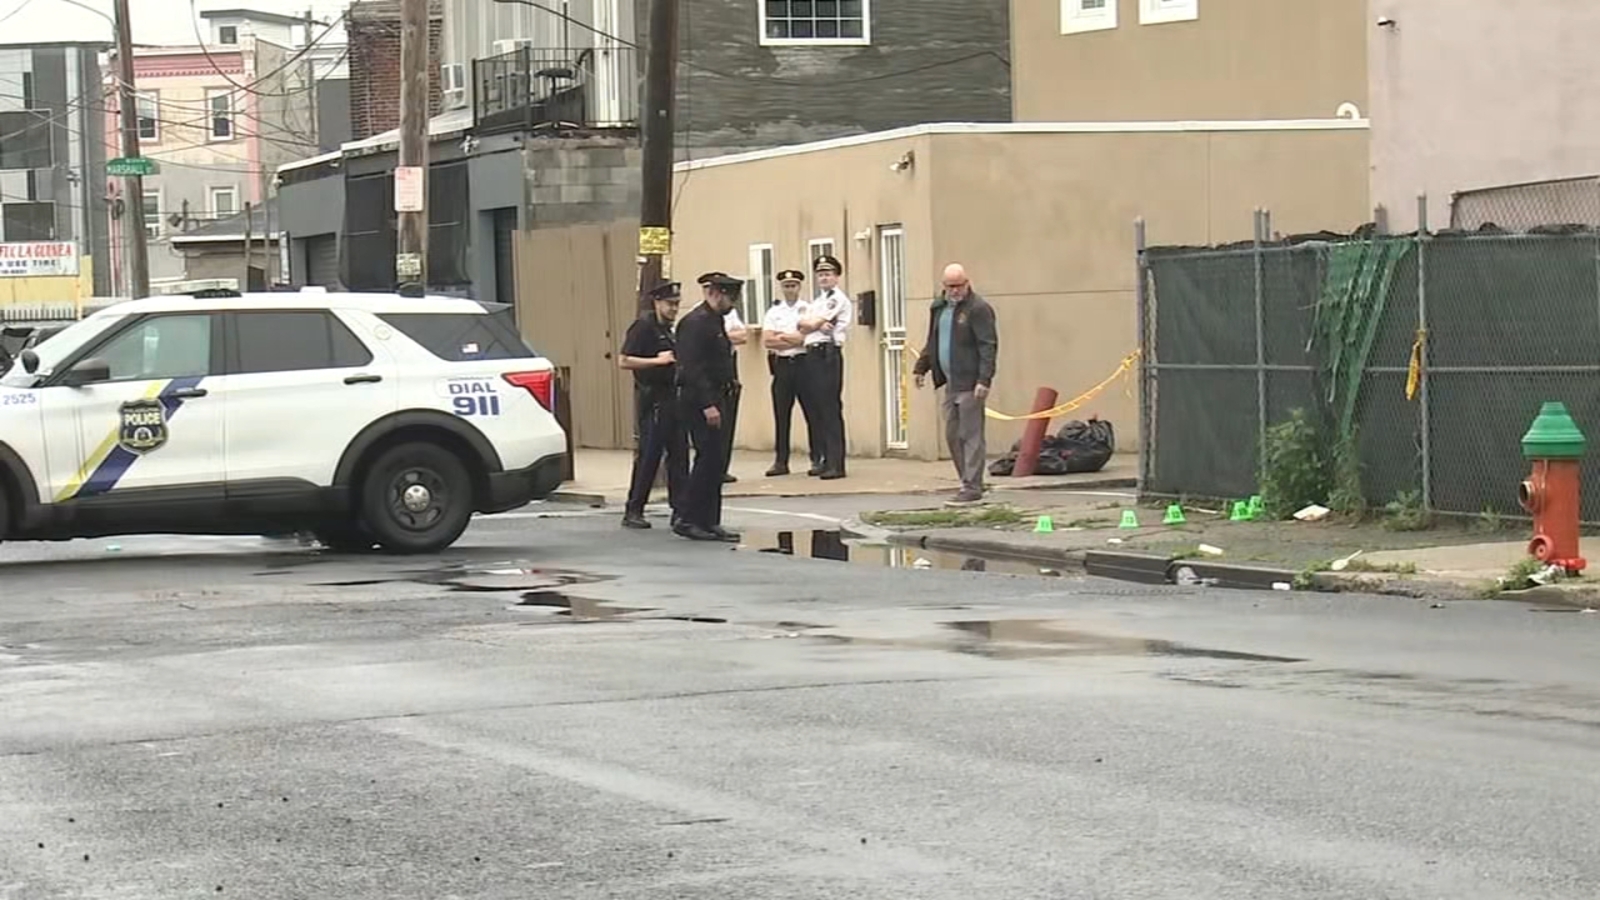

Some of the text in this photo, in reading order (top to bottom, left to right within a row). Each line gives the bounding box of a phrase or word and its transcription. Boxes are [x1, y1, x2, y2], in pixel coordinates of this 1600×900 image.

[106, 164, 144, 174] MARSHALL
[18, 245, 32, 258] LA
[448, 381, 497, 394] DIAL
[3, 392, 36, 405] 2525
[453, 395, 500, 416] 911
[124, 412, 161, 425] POLICE
